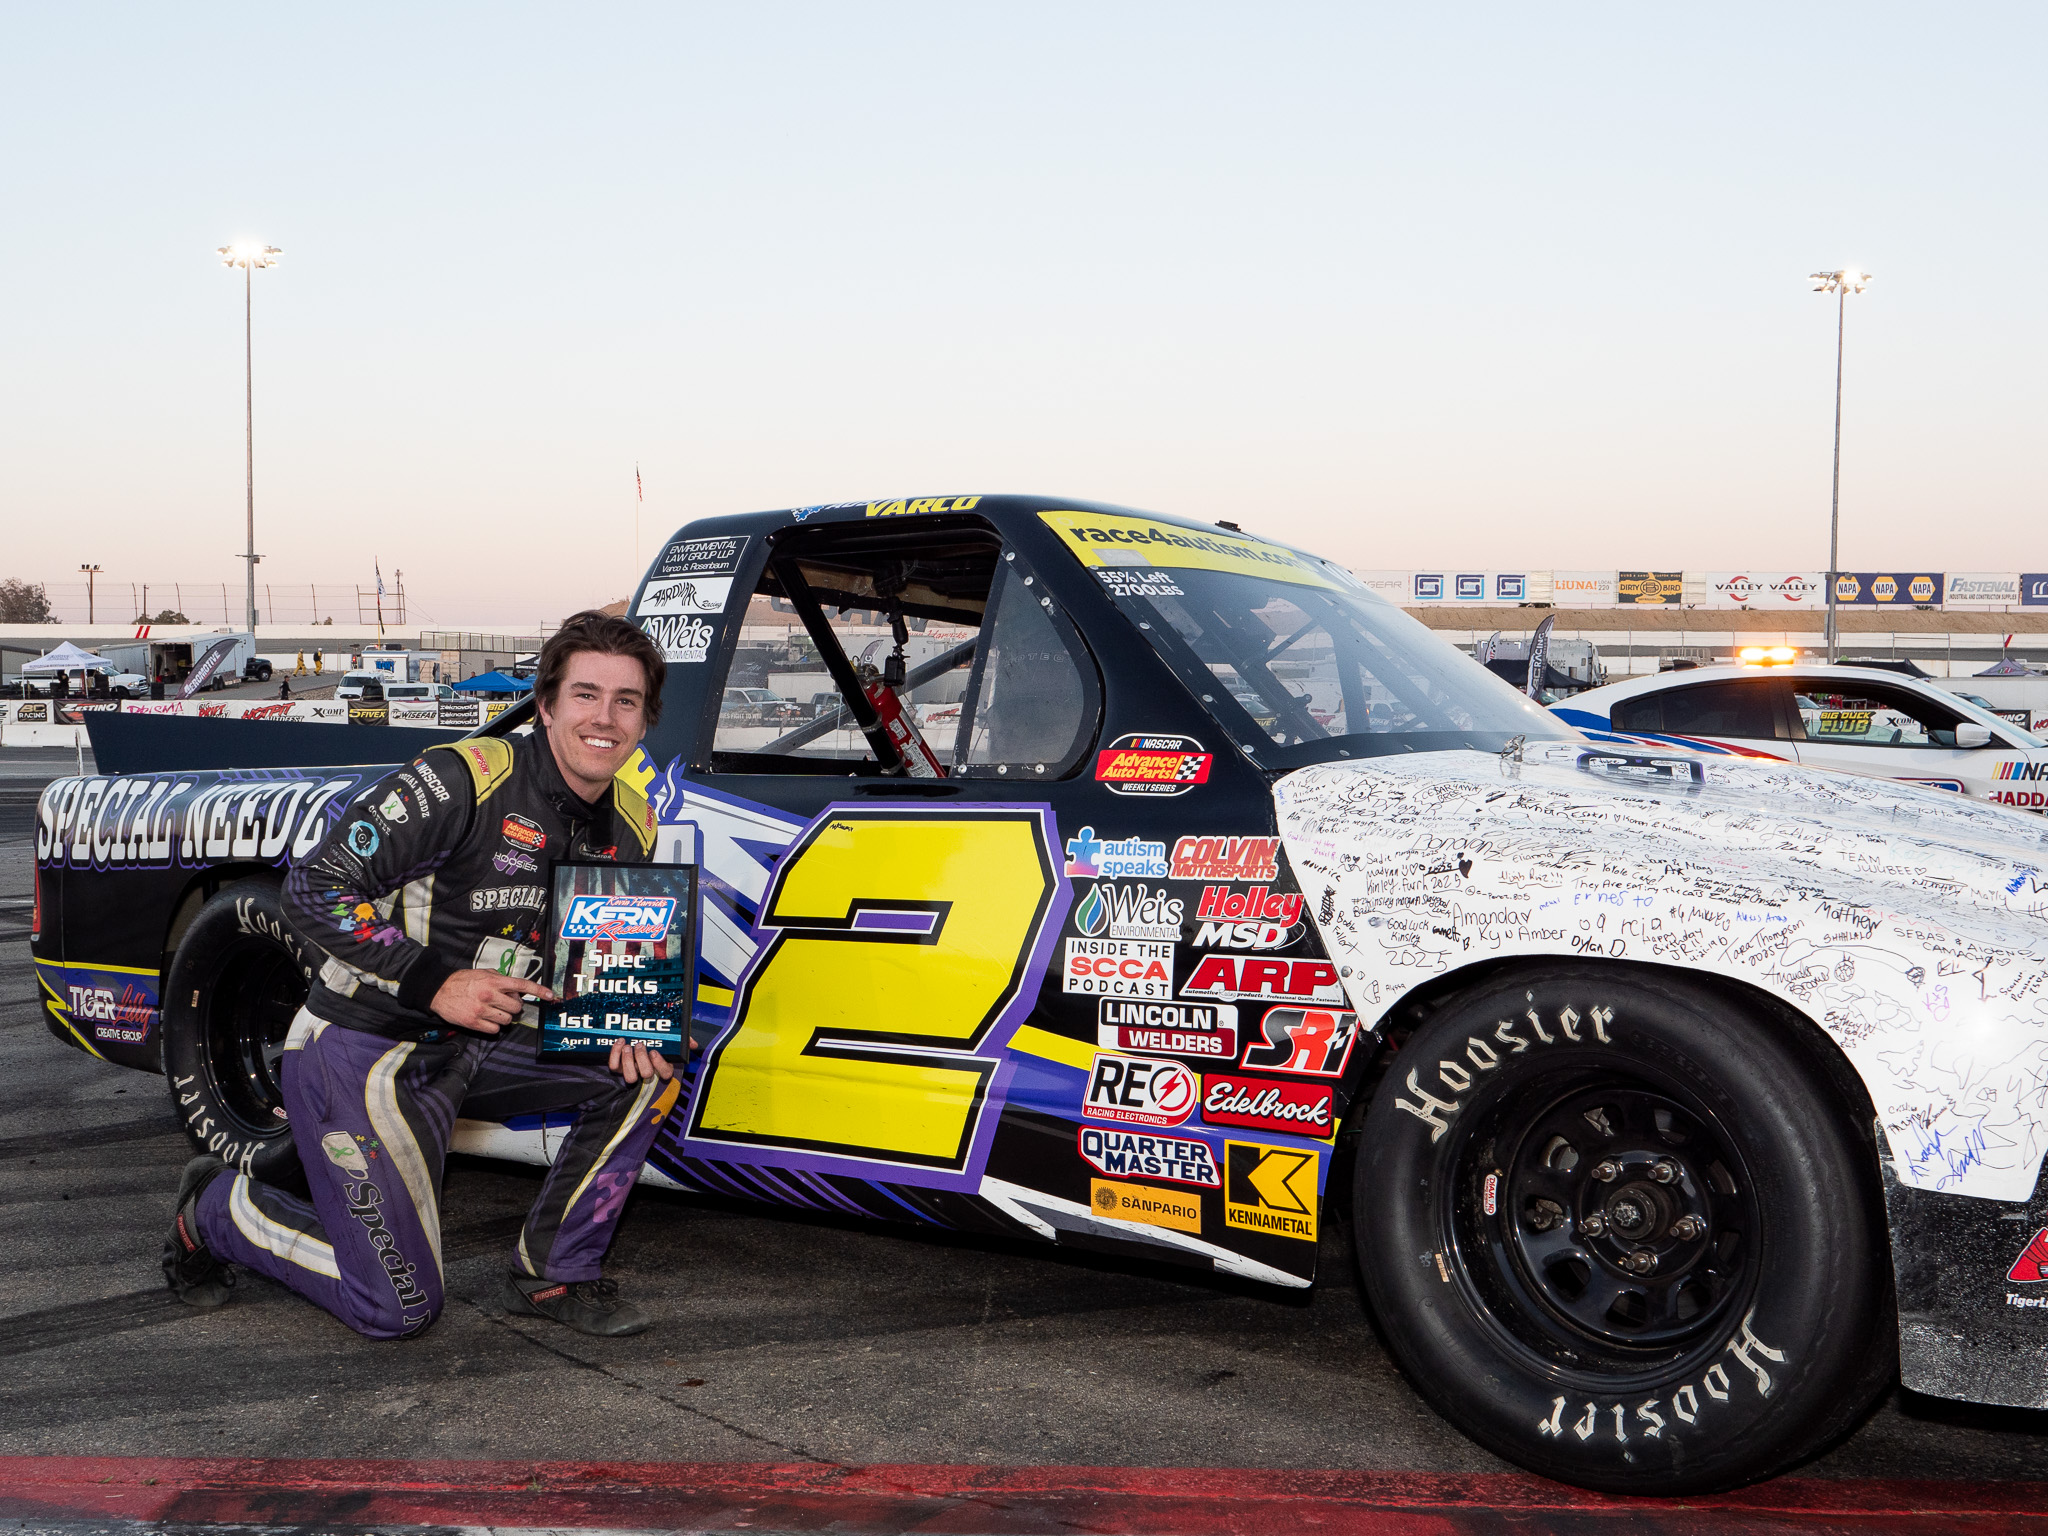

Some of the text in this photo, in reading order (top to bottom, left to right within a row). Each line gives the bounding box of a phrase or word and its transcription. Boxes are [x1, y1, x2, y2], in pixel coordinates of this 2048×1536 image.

[865, 495, 983, 518] VARCO
[665, 549, 735, 564] LAW GROUP LLP
[669, 540, 737, 555] ENVIRONMENTAL
[662, 561, 730, 573] Varco & Rosenbaum
[1098, 570, 1173, 585] 55% Left
[1108, 583, 1185, 597] 2700LBS
[1620, 583, 1681, 592] DIRTY BIRD
[1714, 583, 1763, 591] VALLEY
[1768, 583, 1817, 591] VALLEY
[1838, 583, 1857, 594] NAPA
[1875, 583, 1895, 594] NAPA
[1912, 583, 1932, 594] NAPA
[1949, 577, 2016, 593] FASTENAL
[652, 616, 712, 650] Weis
[184, 649, 221, 697] AEROMOTIVE
[241, 702, 296, 719] HOTPIT
[1820, 711, 1839, 720] BIG
[1820, 719, 1870, 733] CLUB
[1142, 738, 1183, 750] NASCAR
[469, 746, 490, 776] SIMPSON
[1111, 752, 1178, 768] Advance
[415, 762, 451, 803] NASCAR
[1101, 766, 1173, 780] Auto Parts
[1121, 783, 1177, 792] WEEKLY SERIES
[37, 778, 192, 862] SPECIAL
[180, 780, 353, 858] NEEDZ
[367, 804, 392, 836] COFFEE
[1104, 839, 1164, 858] autism
[1171, 838, 1280, 865] COLVIN
[493, 851, 539, 873] HOOSIER
[1102, 857, 1167, 878] speaks
[1169, 863, 1278, 880] MOTORSPORTS
[571, 900, 667, 926] KERN
[1103, 884, 1184, 926] Weis
[1196, 886, 1305, 928] Holley
[589, 920, 666, 944] Raceway
[1110, 924, 1181, 938] ENVIRONMENTAL
[1192, 922, 1288, 949] MSD
[1070, 940, 1171, 958] INSIDE THE
[588, 949, 647, 972] Spec
[1069, 956, 1169, 981] SCCA
[1385, 949, 1453, 974] 2025
[573, 973, 659, 995] Trucks
[1186, 957, 1339, 996] ARP
[690, 813, 1053, 1168] 2
[1069, 978, 1170, 997] PODCAST
[1184, 988, 1219, 996] automotive
[1236, 991, 1264, 999] products
[69, 985, 117, 1021] TIGER
[558, 1012, 672, 1032] 1st Place
[1105, 1002, 1213, 1030] LINCOLN
[96, 1027, 143, 1042] CREATIVE GROUP
[560, 1036, 591, 1047] April
[1128, 1029, 1223, 1054] WELDERS
[1394, 989, 1617, 1144] Hoosier
[1203, 1081, 1331, 1126] Edelbrock
[1086, 1107, 1168, 1125] RACING ELECTRONICS
[173, 1074, 267, 1180] Hoosier
[1082, 1129, 1208, 1164] QUARTER
[1104, 1150, 1216, 1184] MASTER
[1121, 1196, 1197, 1219] SANPARIO
[1228, 1208, 1313, 1236] KENNAMETAL
[343, 1180, 429, 1309] Special
[533, 1286, 568, 1302] PYROTECT
[2005, 1293, 2048, 1308] TigerL
[1536, 1306, 1788, 1465] Hoosier
